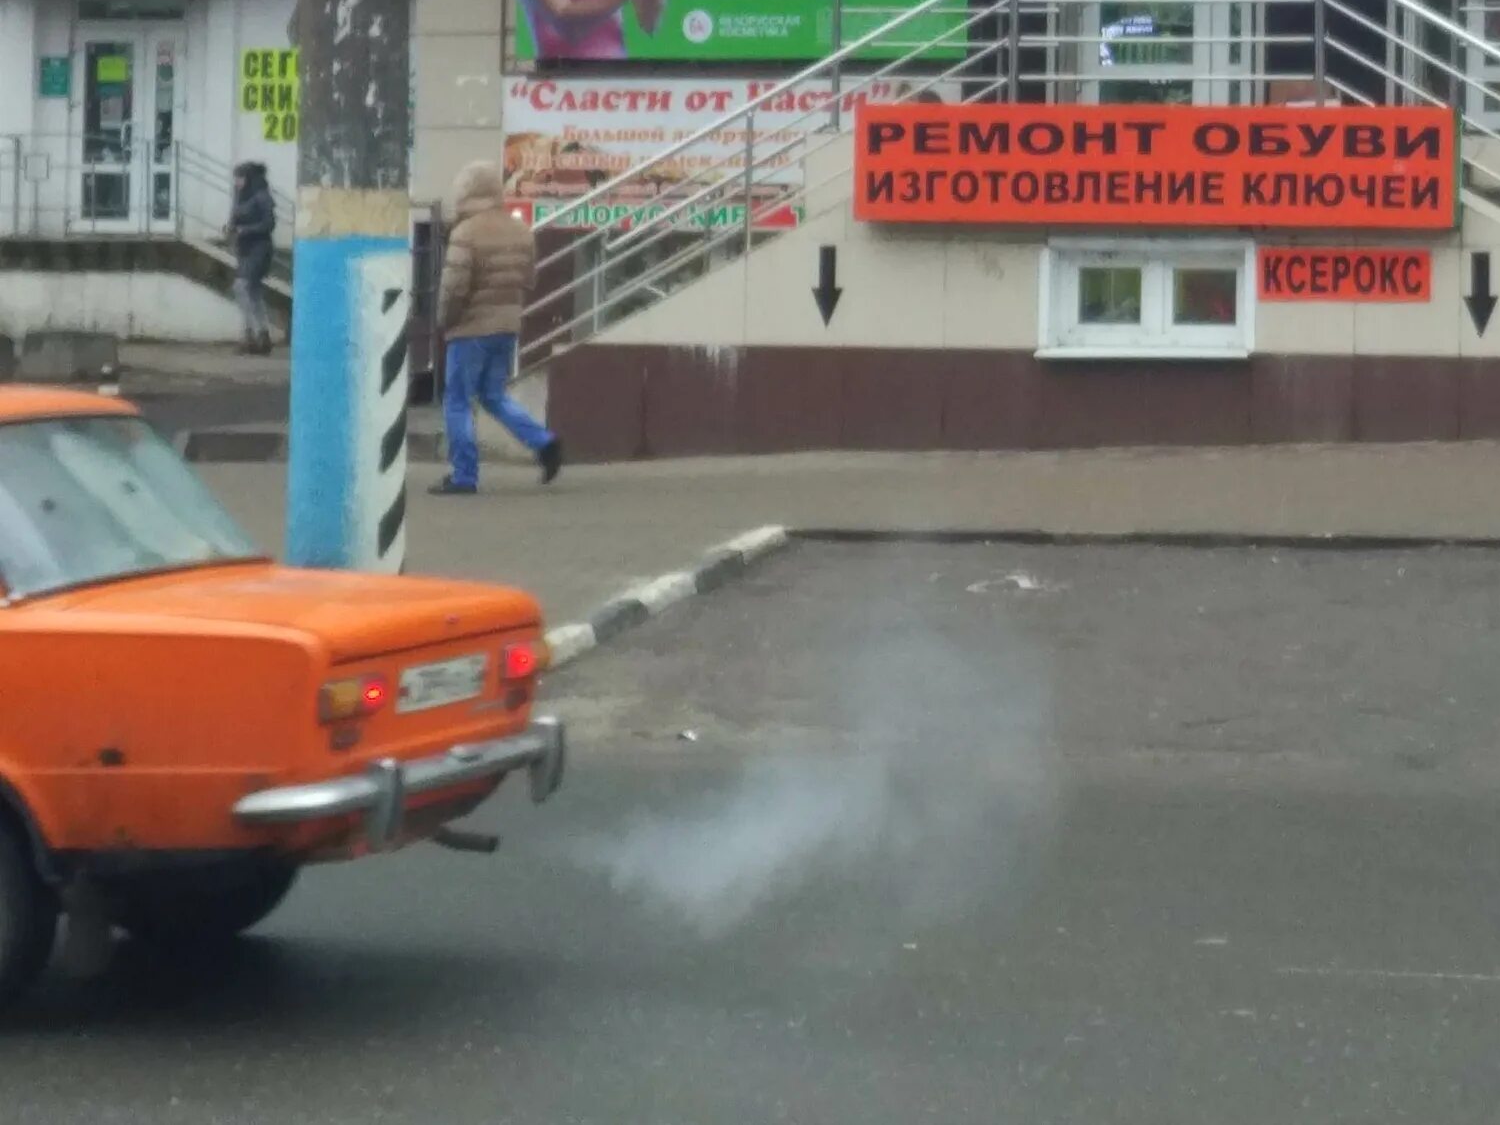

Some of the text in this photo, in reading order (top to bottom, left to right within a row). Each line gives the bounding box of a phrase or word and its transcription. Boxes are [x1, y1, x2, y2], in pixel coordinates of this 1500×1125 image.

[243, 50, 302, 79] СЕГ
[243, 82, 299, 111] СКИ
[684, 91, 733, 112] от
[866, 121, 1442, 160] РЕМОНТ ОБУВИ
[866, 171, 1225, 206] ИЗГОТОВЛЕНИЕ
[1263, 254, 1423, 295] КСЕРОКС
